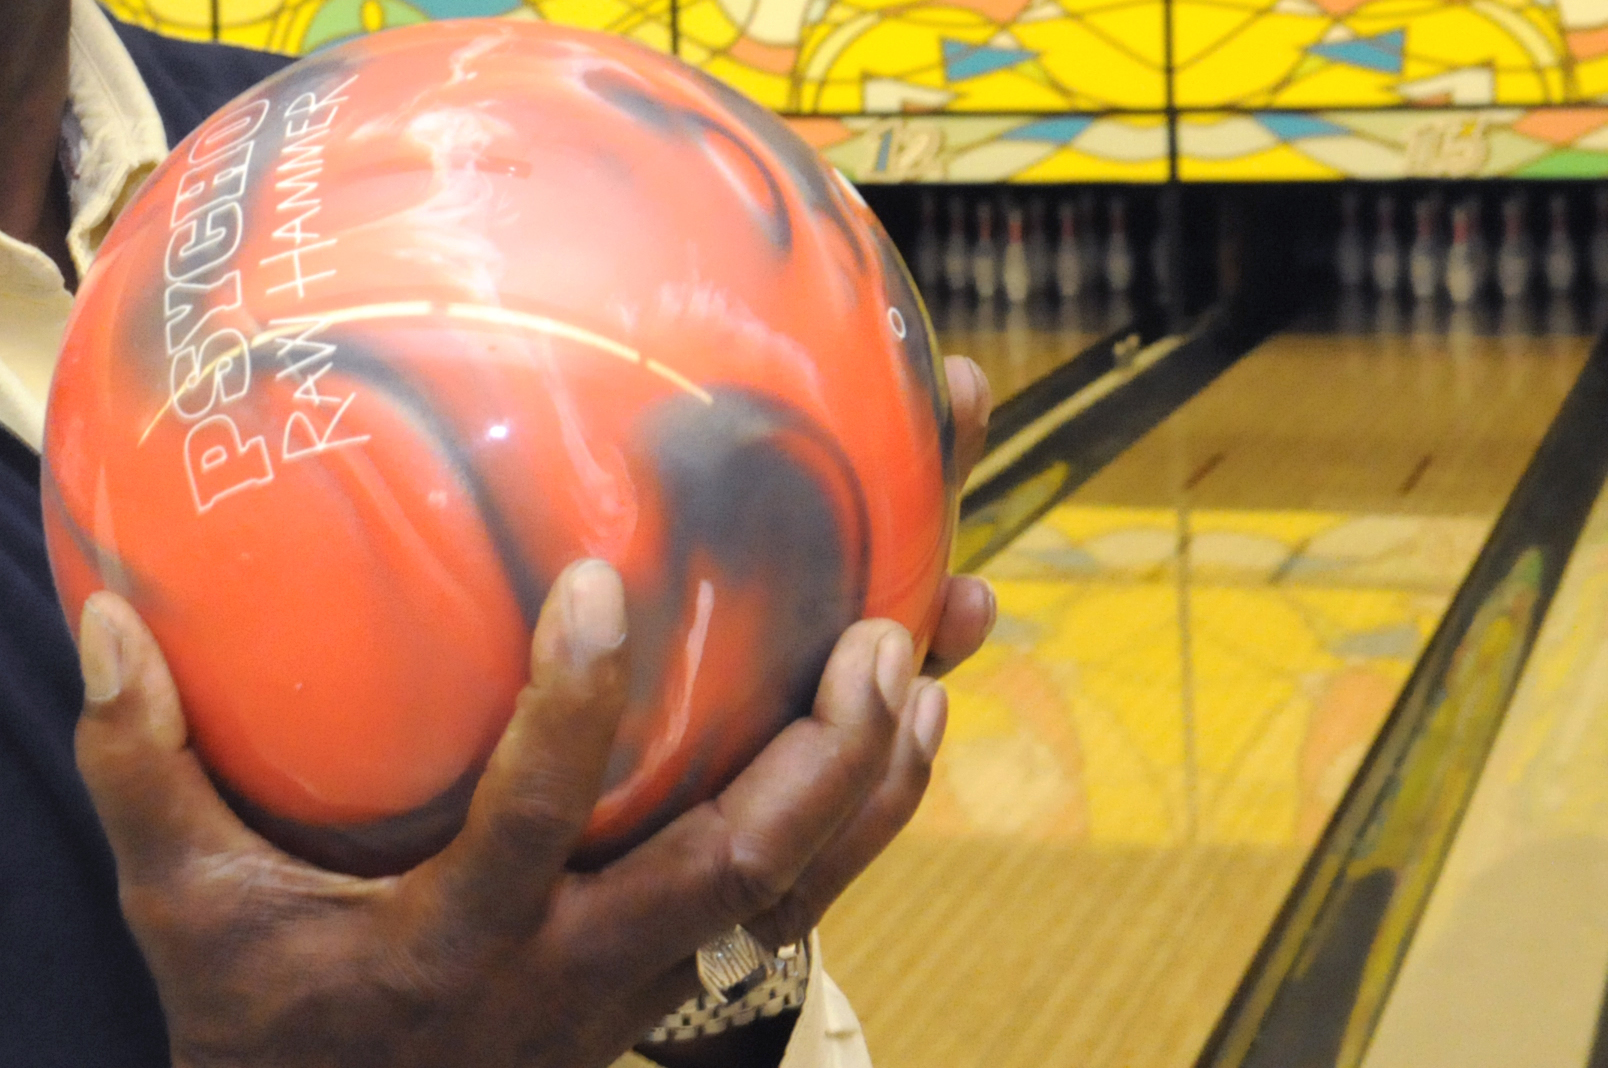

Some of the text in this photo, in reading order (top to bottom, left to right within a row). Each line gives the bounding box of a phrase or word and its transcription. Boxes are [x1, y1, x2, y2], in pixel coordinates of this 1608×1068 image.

[164, 98, 275, 515] PSYCHO
[258, 73, 372, 461] RAW HAMMER
